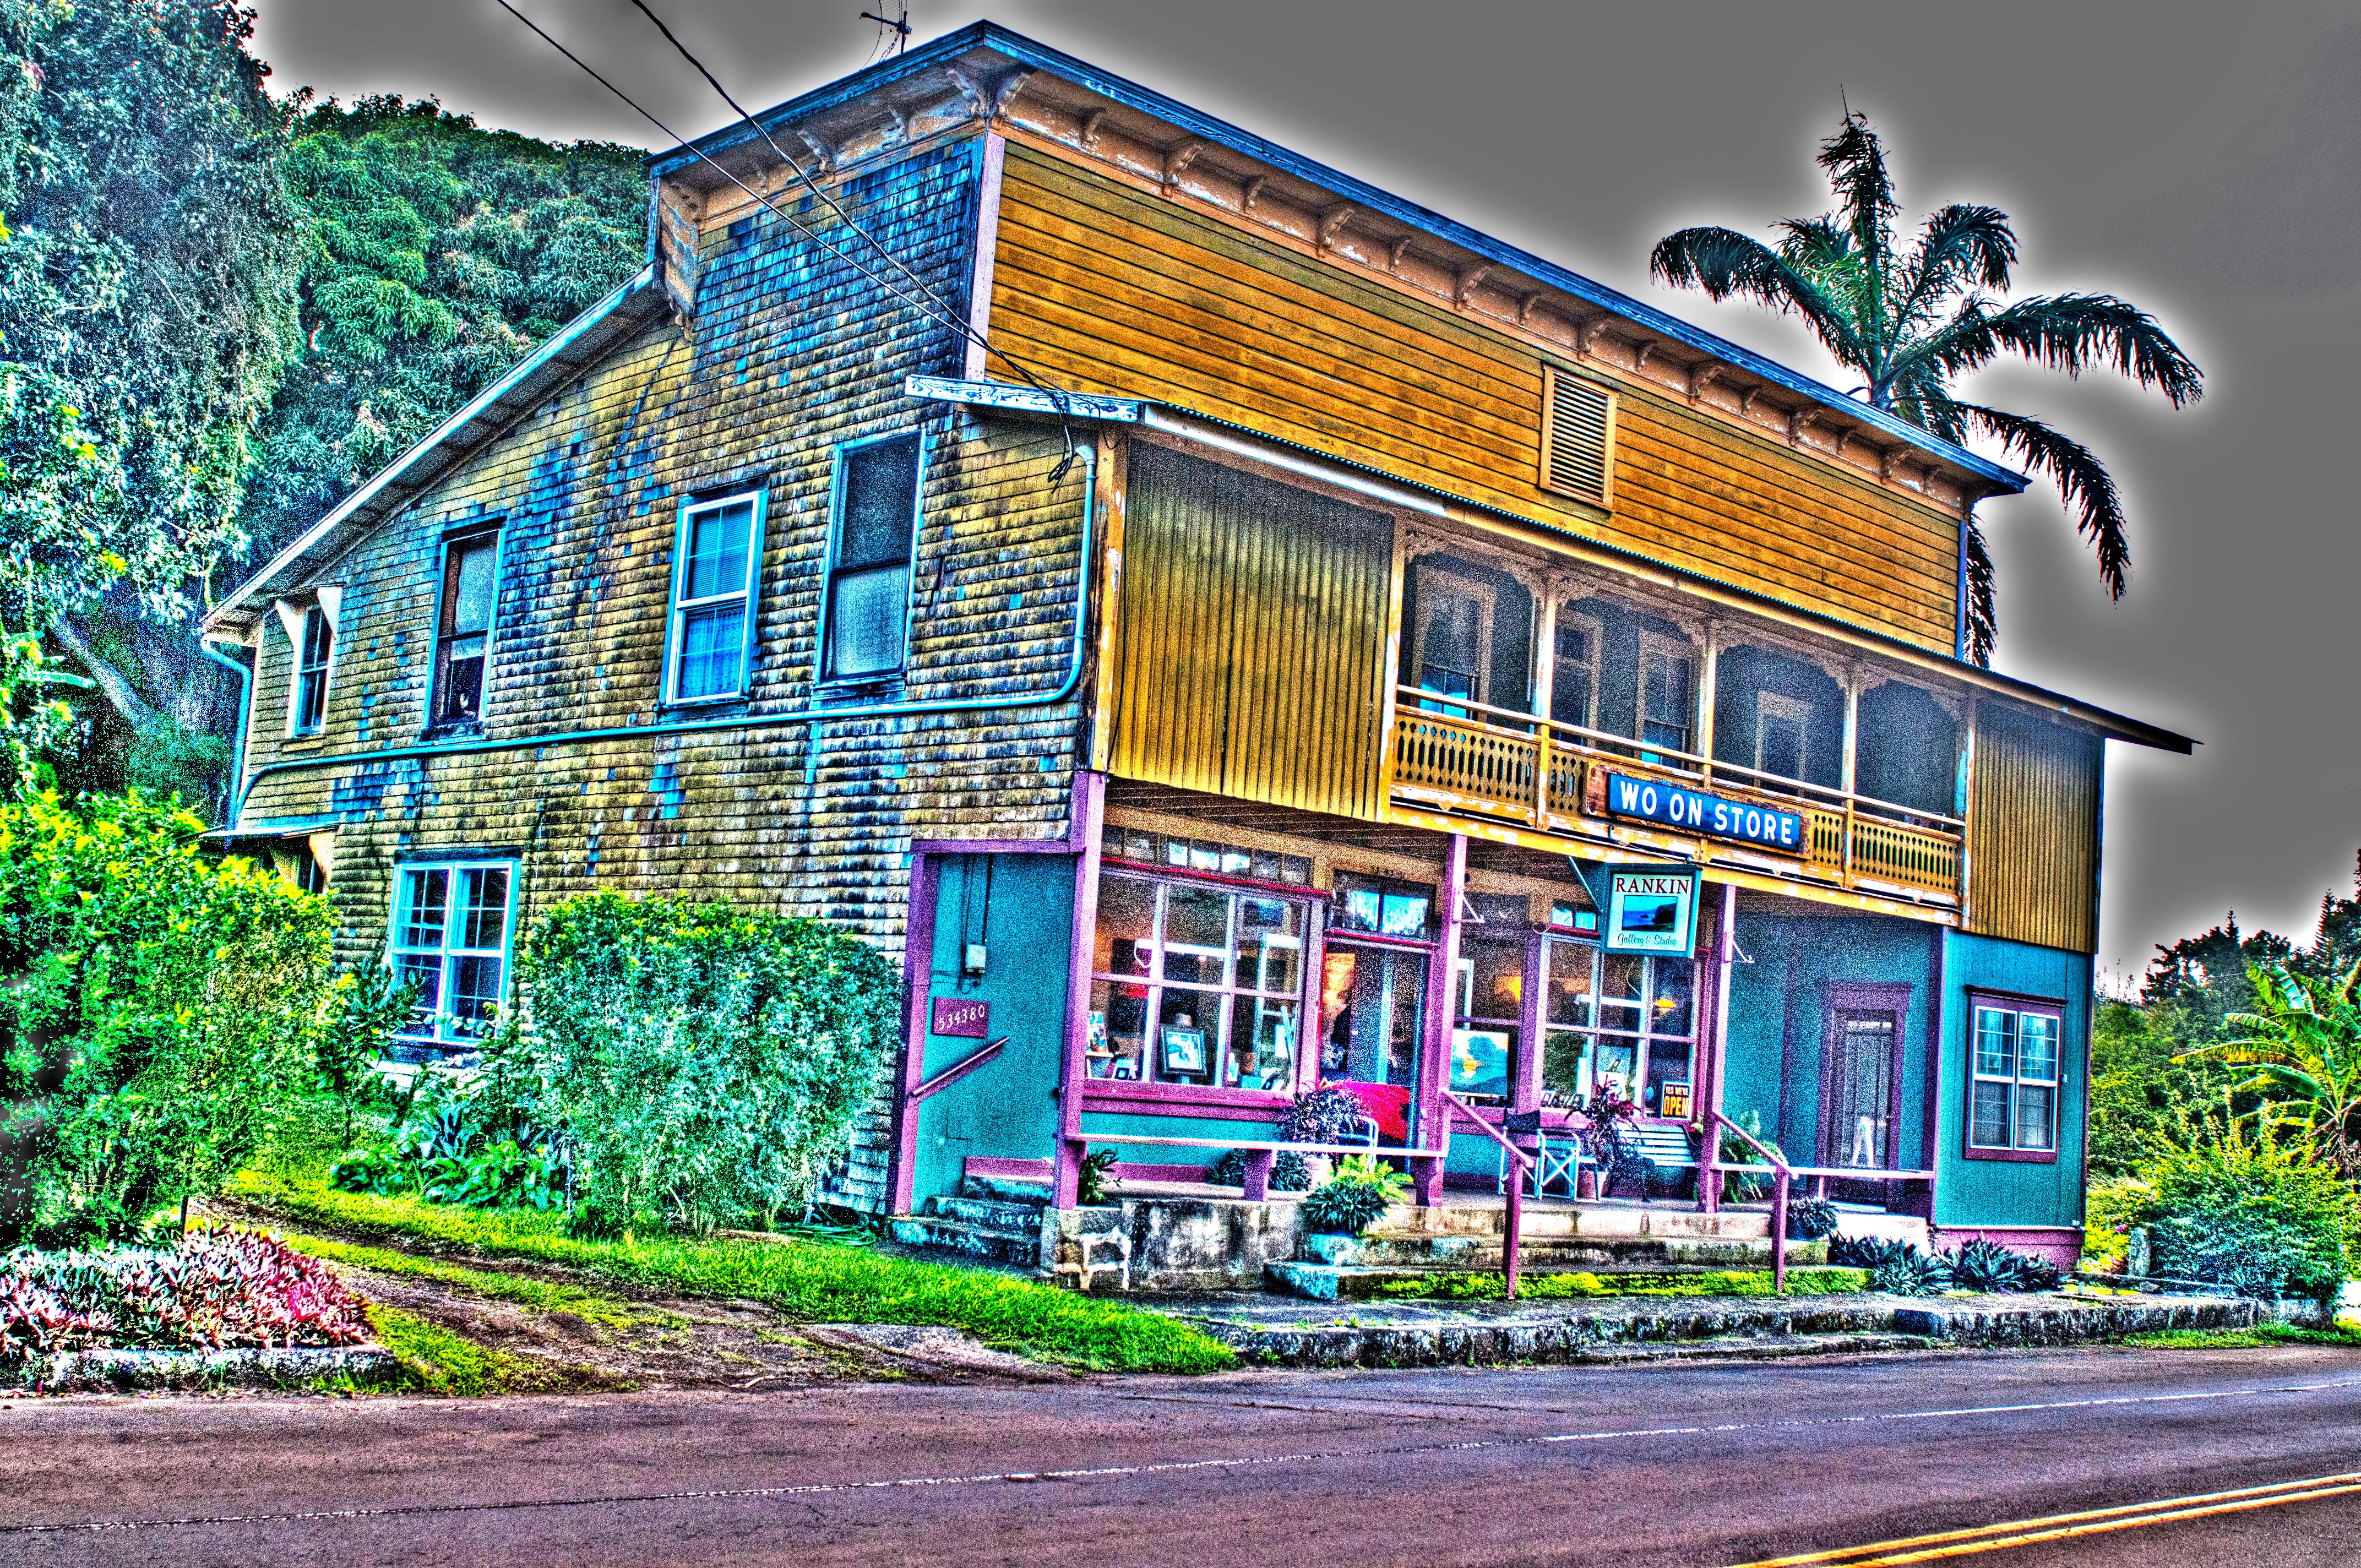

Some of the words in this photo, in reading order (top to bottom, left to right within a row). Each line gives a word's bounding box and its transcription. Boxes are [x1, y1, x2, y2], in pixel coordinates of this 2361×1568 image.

[1620, 781, 1657, 815] WO
[1669, 793, 1702, 826] ON
[1714, 803, 1792, 844] STORE
[1615, 878, 1689, 894] RANKIN
[1617, 933, 1644, 946] Gallery
[1645, 935, 1651, 944] &
[1653, 934, 1677, 946] Studio
[938, 1005, 985, 1031] 534380
[1666, 1086, 1674, 1095] YES
[1663, 1096, 1689, 1116] OPEN
